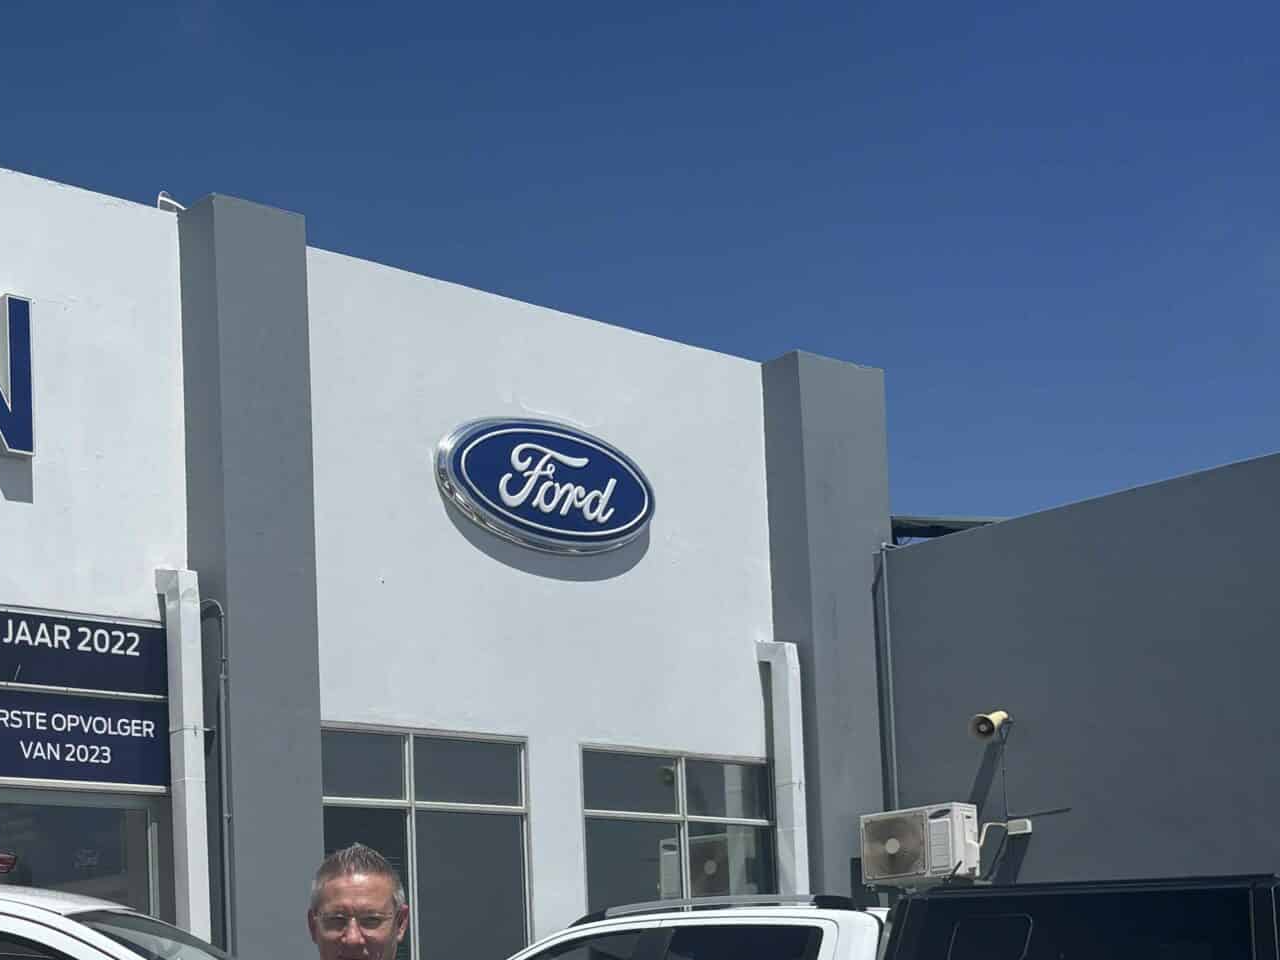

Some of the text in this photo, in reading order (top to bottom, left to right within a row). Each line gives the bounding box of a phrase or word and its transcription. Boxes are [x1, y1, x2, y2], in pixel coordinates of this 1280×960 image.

[498, 443, 617, 523] Ford
[2, 620, 71, 650] JAAR
[76, 626, 141, 657] 2022
[50, 711, 156, 739] OPVOLGER
[19, 739, 113, 765] VAN 2023
